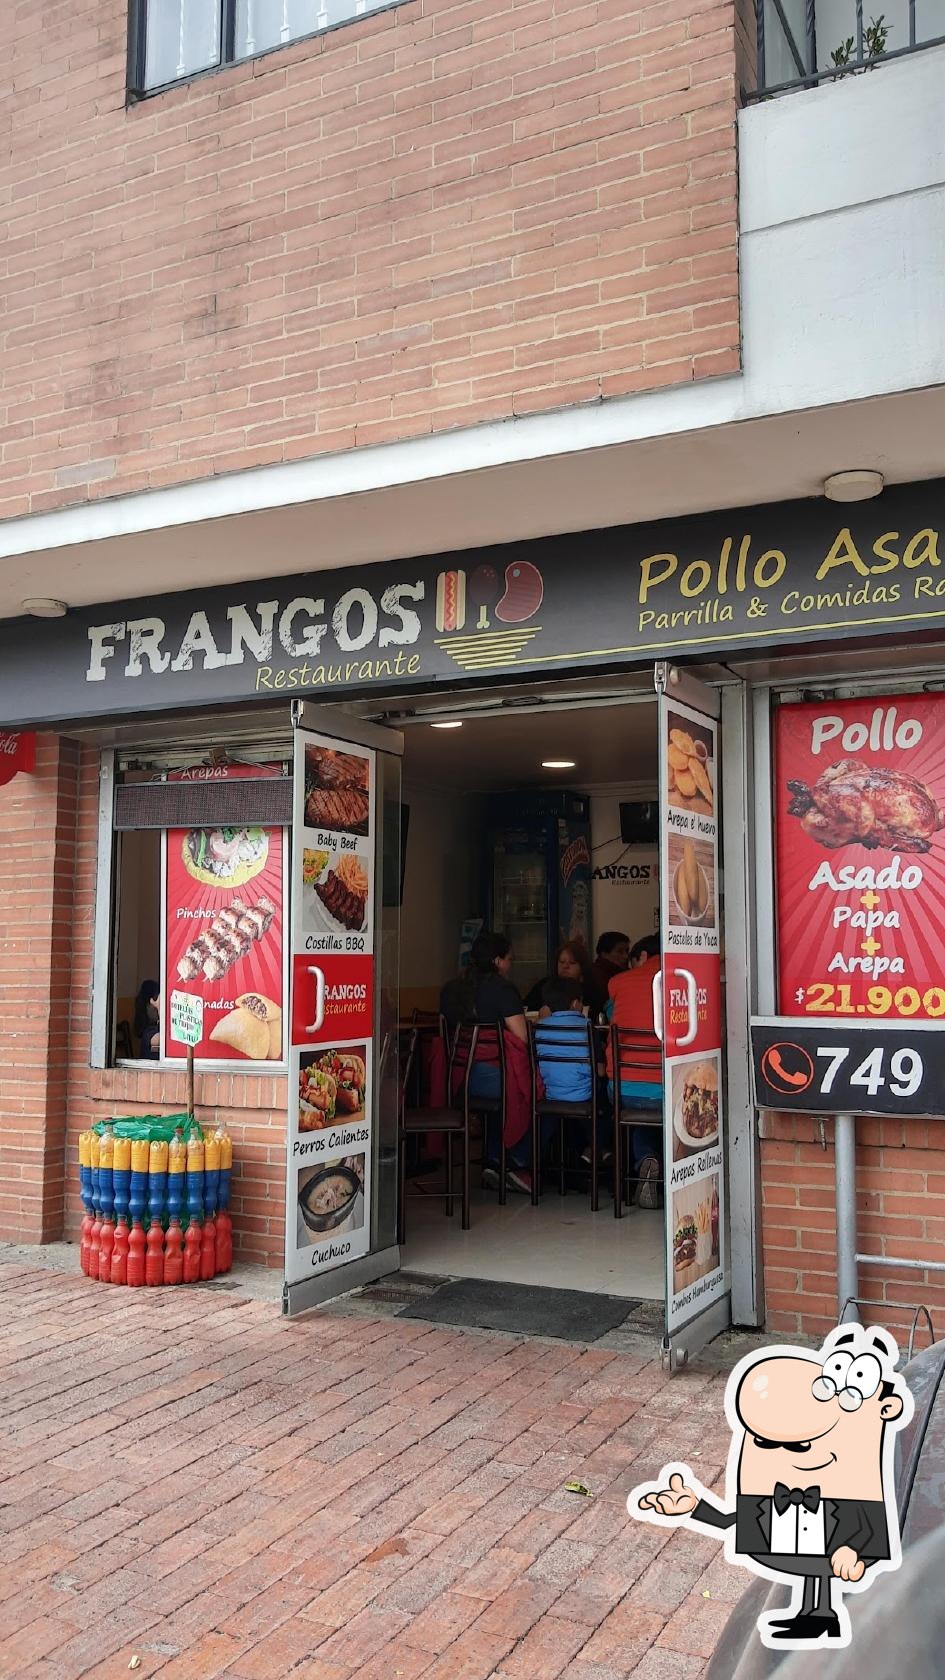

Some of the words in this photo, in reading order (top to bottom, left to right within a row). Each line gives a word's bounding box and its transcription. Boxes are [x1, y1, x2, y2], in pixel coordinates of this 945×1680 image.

[639, 534, 787, 604] Pollo
[815, 528, 941, 581] Asa
[638, 599, 734, 632] Parrilla
[746, 597, 768, 618] &
[781, 580, 901, 615] Comidas
[85, 580, 425, 682] FRANGOS
[254, 650, 421, 691] Restaurante
[810, 706, 923, 754] Pollo
[181, 765, 228, 780] Arepas
[667, 809, 689, 833] Arepa
[697, 816, 716, 836] huevo
[317, 833, 338, 851] Baby
[340, 837, 358, 850] Beef
[592, 864, 651, 879] ANGOS
[809, 855, 923, 890] Asado
[176, 907, 217, 919] Pinchos
[833, 906, 900, 936] Papa
[305, 935, 342, 950] Costillas
[345, 937, 365, 952] BBQ
[668, 930, 693, 946] Pasteles
[694, 932, 702, 946] de
[828, 952, 905, 980] Arepa
[203, 997, 235, 1010] nadas
[322, 984, 366, 1000] RANGOS
[669, 988, 707, 1007] FRAOS
[324, 1001, 366, 1015] staurante
[670, 1007, 707, 1024] Restante
[816, 1047, 924, 1097] 749
[293, 1138, 325, 1156] Perros
[328, 1128, 369, 1148] Calientes
[671, 1162, 695, 1185] Arepas
[697, 1151, 723, 1172] Rellenas
[311, 1242, 351, 1266] Cuchuco
[671, 1292, 692, 1314] Combos
